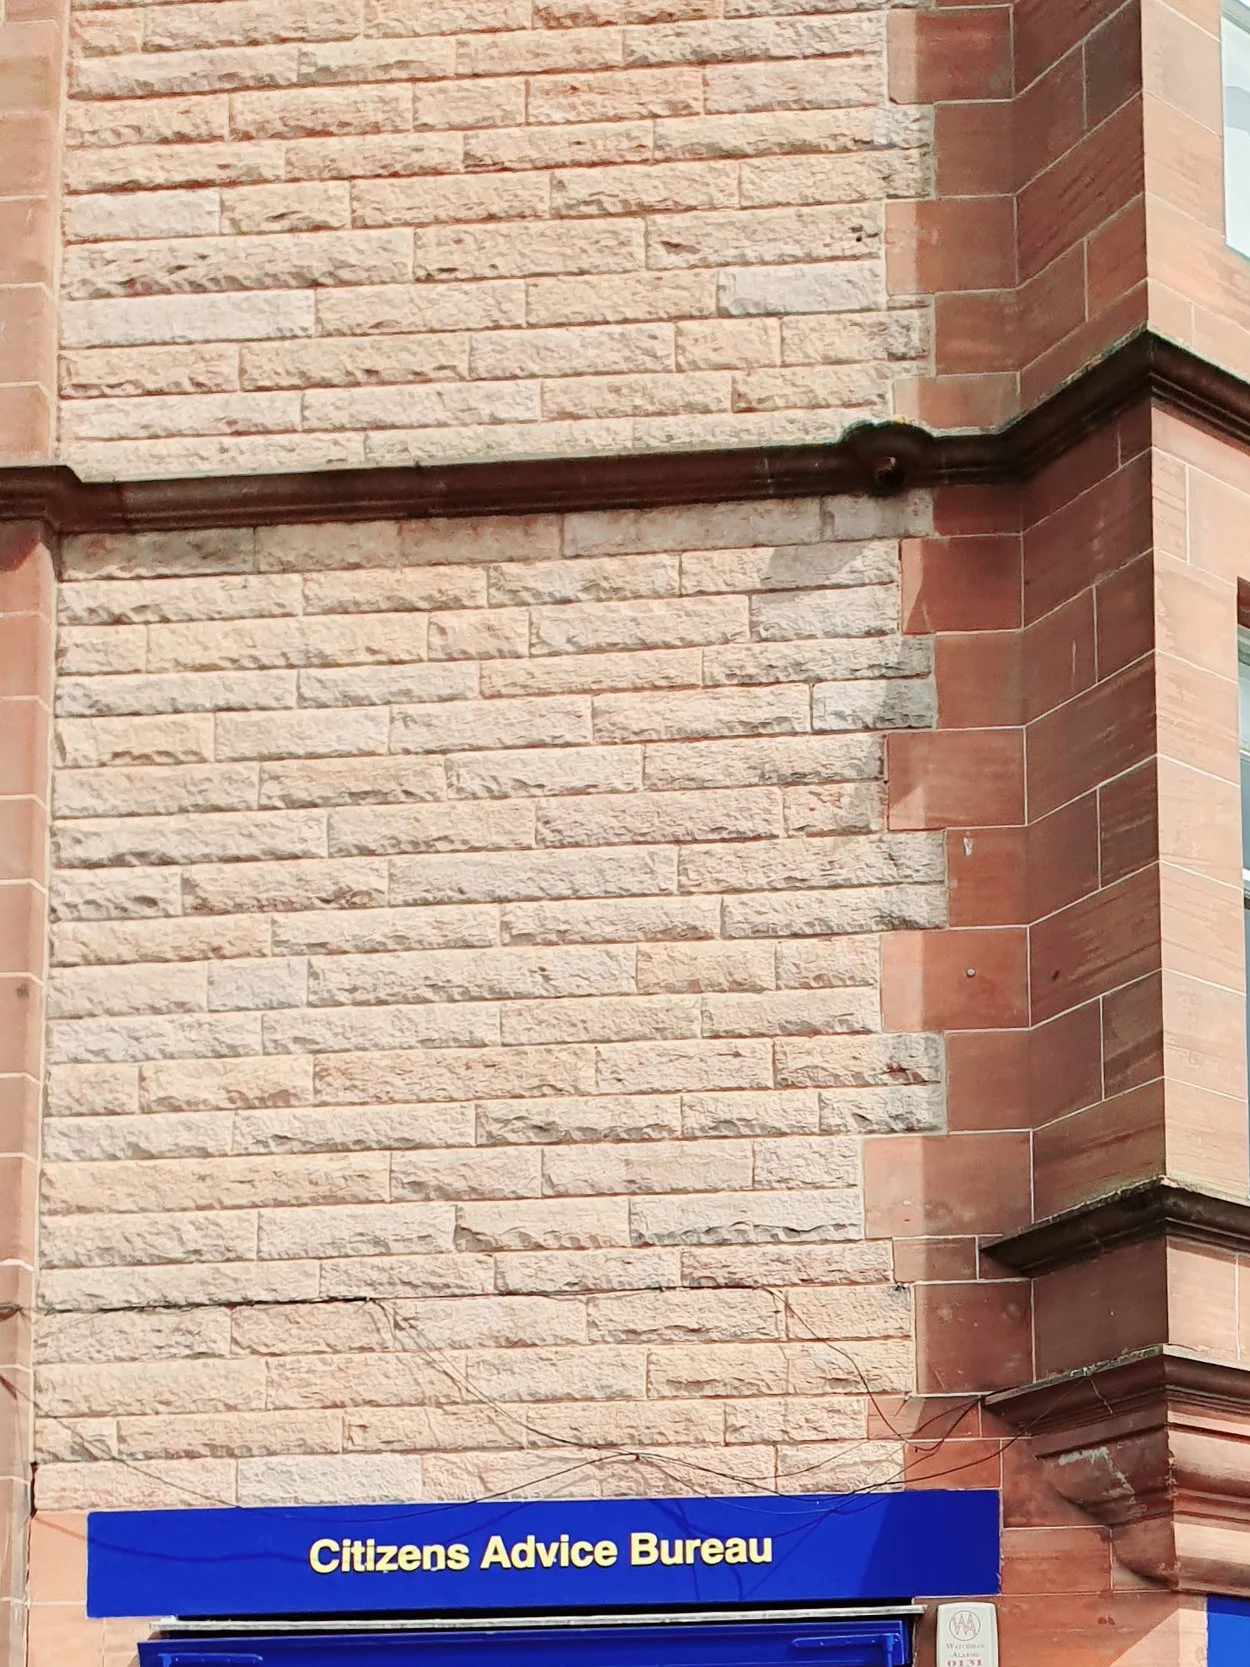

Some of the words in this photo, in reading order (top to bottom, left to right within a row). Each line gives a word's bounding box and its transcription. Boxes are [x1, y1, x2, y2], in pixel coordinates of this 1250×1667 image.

[308, 1538, 470, 1574] Citizens
[480, 1534, 618, 1570] Advice
[629, 1532, 774, 1567] Bureau
[946, 1659, 982, 1667] 0131
